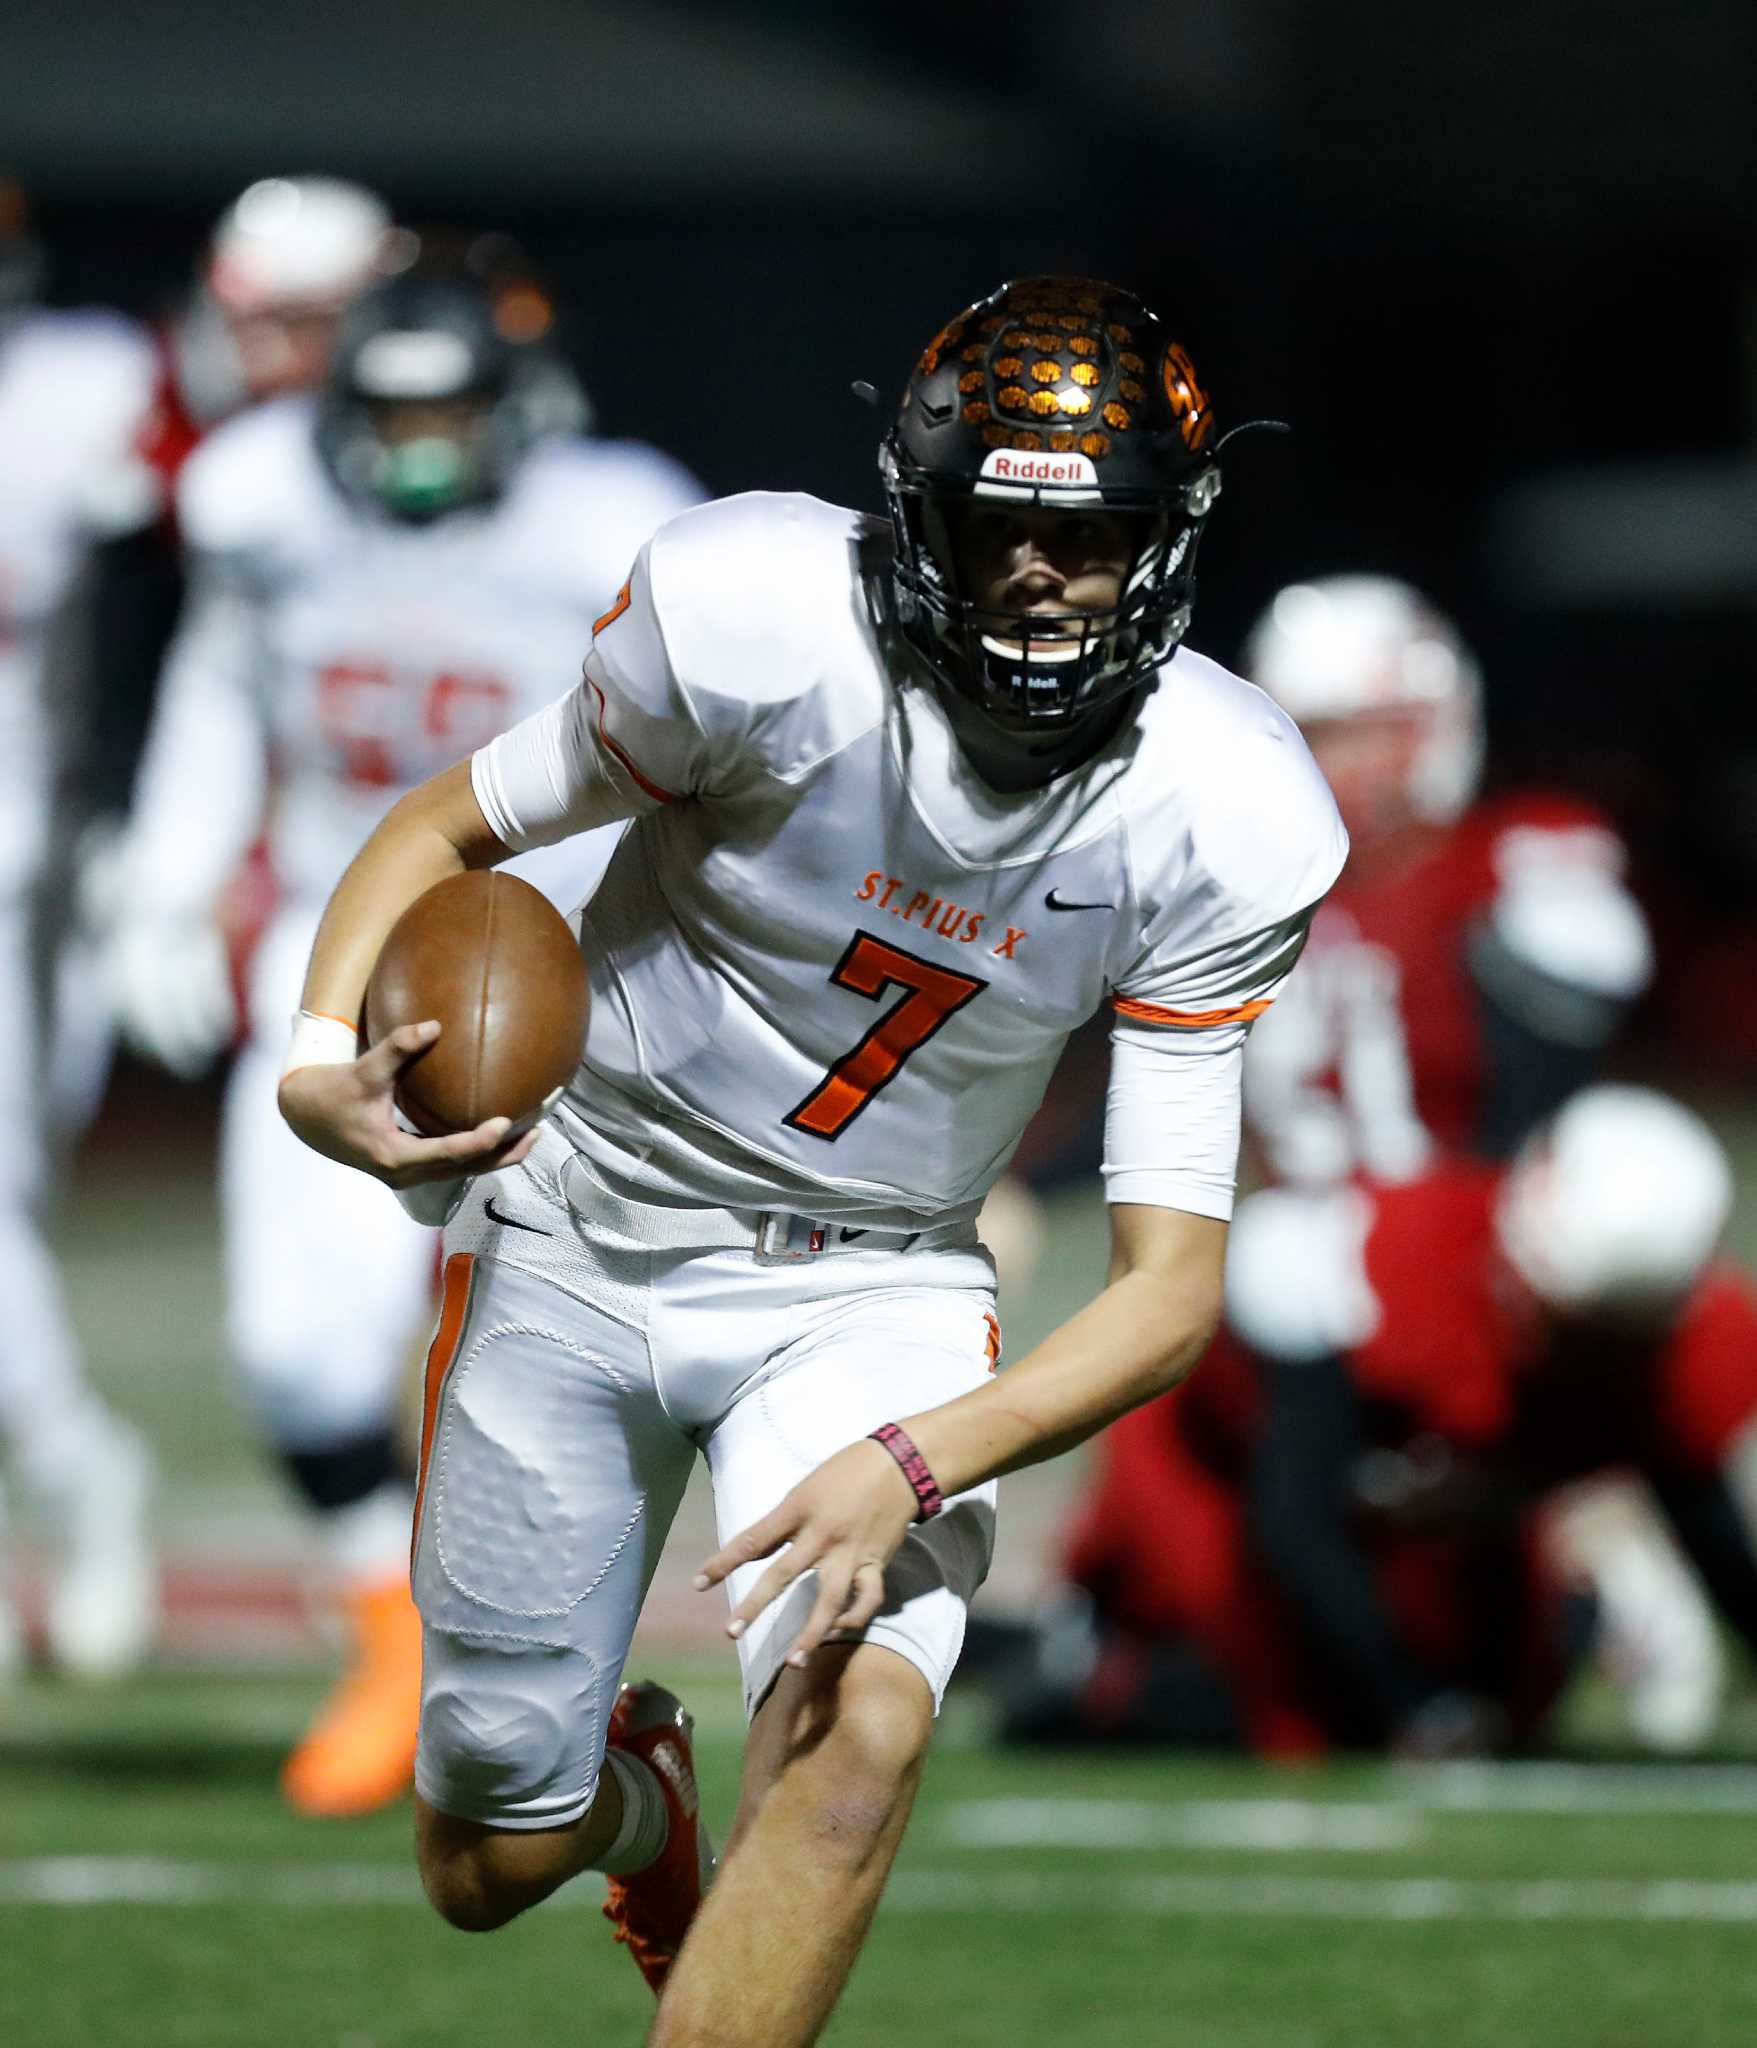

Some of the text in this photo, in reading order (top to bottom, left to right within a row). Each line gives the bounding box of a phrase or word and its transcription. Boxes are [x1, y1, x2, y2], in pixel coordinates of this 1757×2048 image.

[995, 458, 1082, 480] Riddell
[993, 926, 1026, 959] X
[782, 929, 989, 1142] 7
